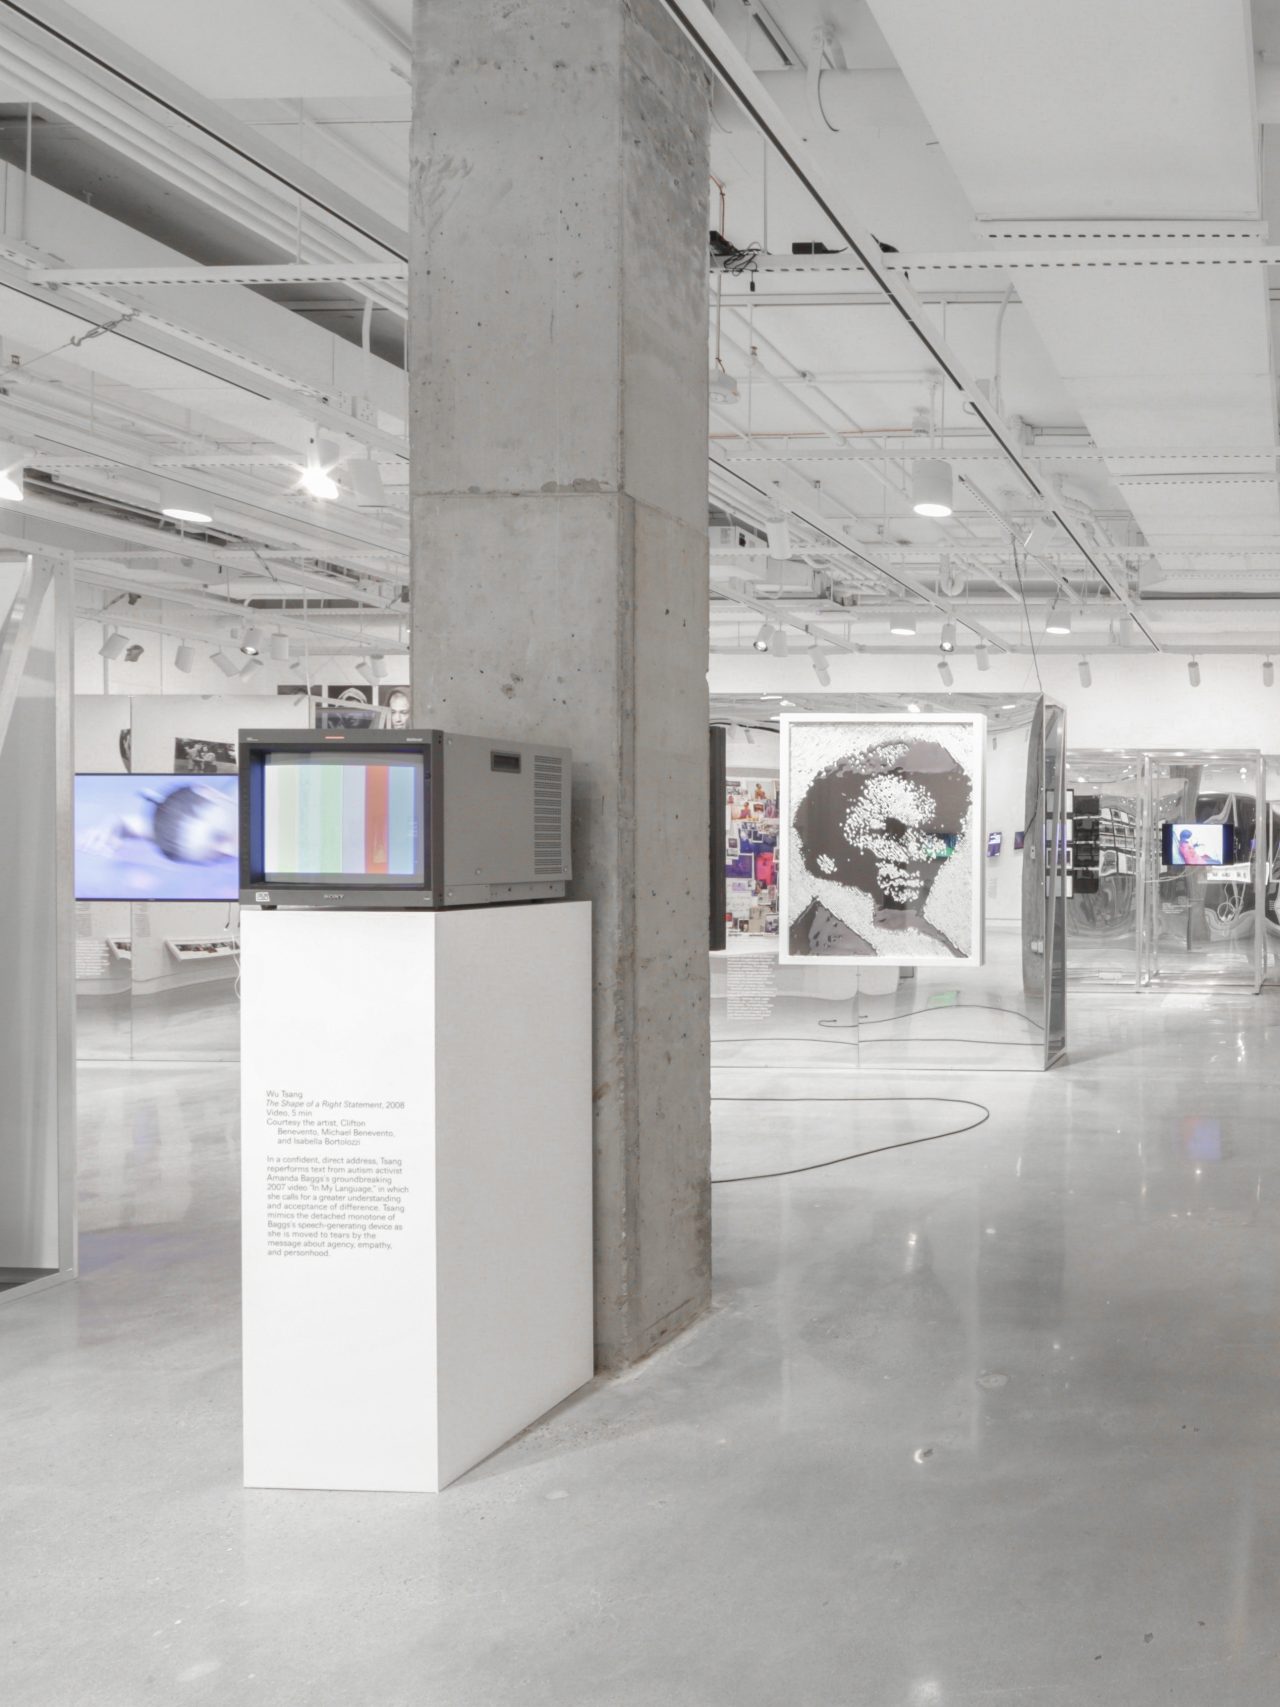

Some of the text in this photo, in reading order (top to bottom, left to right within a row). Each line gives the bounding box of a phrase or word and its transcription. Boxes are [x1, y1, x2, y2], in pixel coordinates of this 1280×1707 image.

[282, 1090, 303, 1099] Tsang
[281, 1100, 304, 1109] Shape
[322, 1100, 342, 1109] Right
[266, 1118, 301, 1128] Courtesy
[294, 1137, 322, 1145] Isabella
[381, 1158, 402, 1167] Tsang
[267, 1165, 309, 1174] reperforms
[331, 1176, 392, 1186] groundbreaking
[321, 1185, 333, 1193] My
[318, 1195, 346, 1203] greater
[347, 1195, 401, 1205] understanding
[284, 1204, 327, 1212] acceptance
[383, 1205, 404, 1214] Tsang
[297, 1222, 366, 1232] speech-generating
[352, 1232, 362, 1241] by
